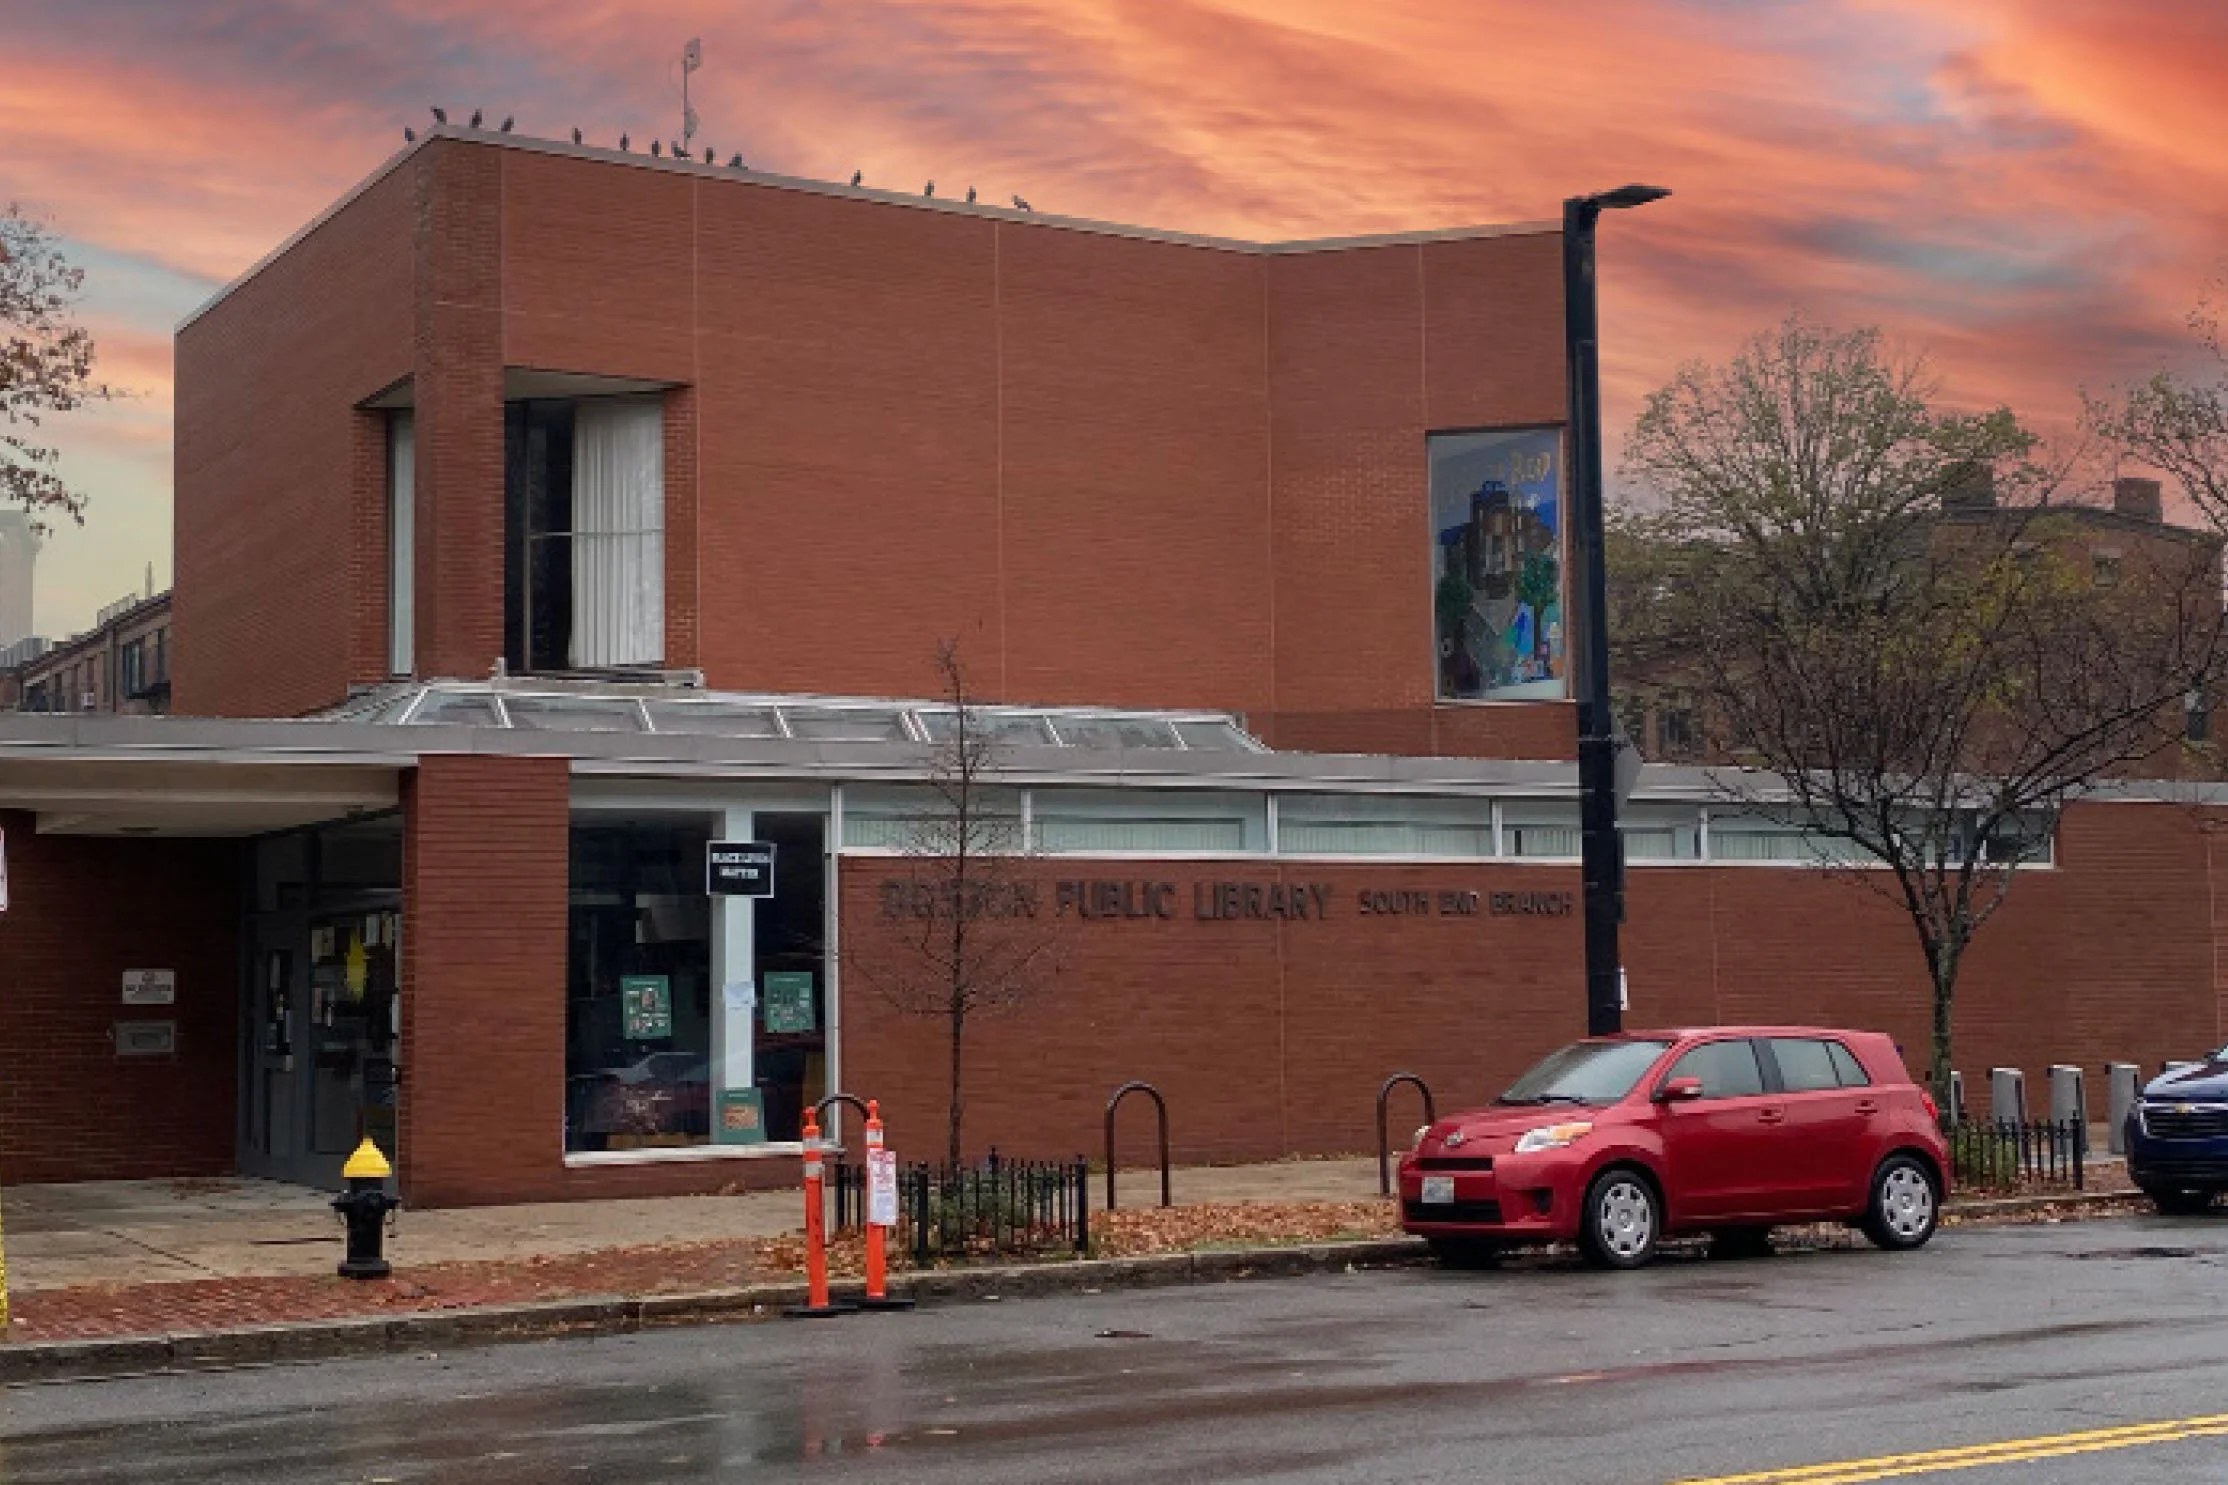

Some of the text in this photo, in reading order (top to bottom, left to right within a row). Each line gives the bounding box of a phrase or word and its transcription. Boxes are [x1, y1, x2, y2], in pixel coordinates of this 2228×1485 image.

[1055, 880, 1176, 920] PUBLIC
[1193, 881, 1332, 921] LIBRARY
[1358, 890, 1430, 916] SOUTH
[1489, 891, 1574, 917] BRANCH
